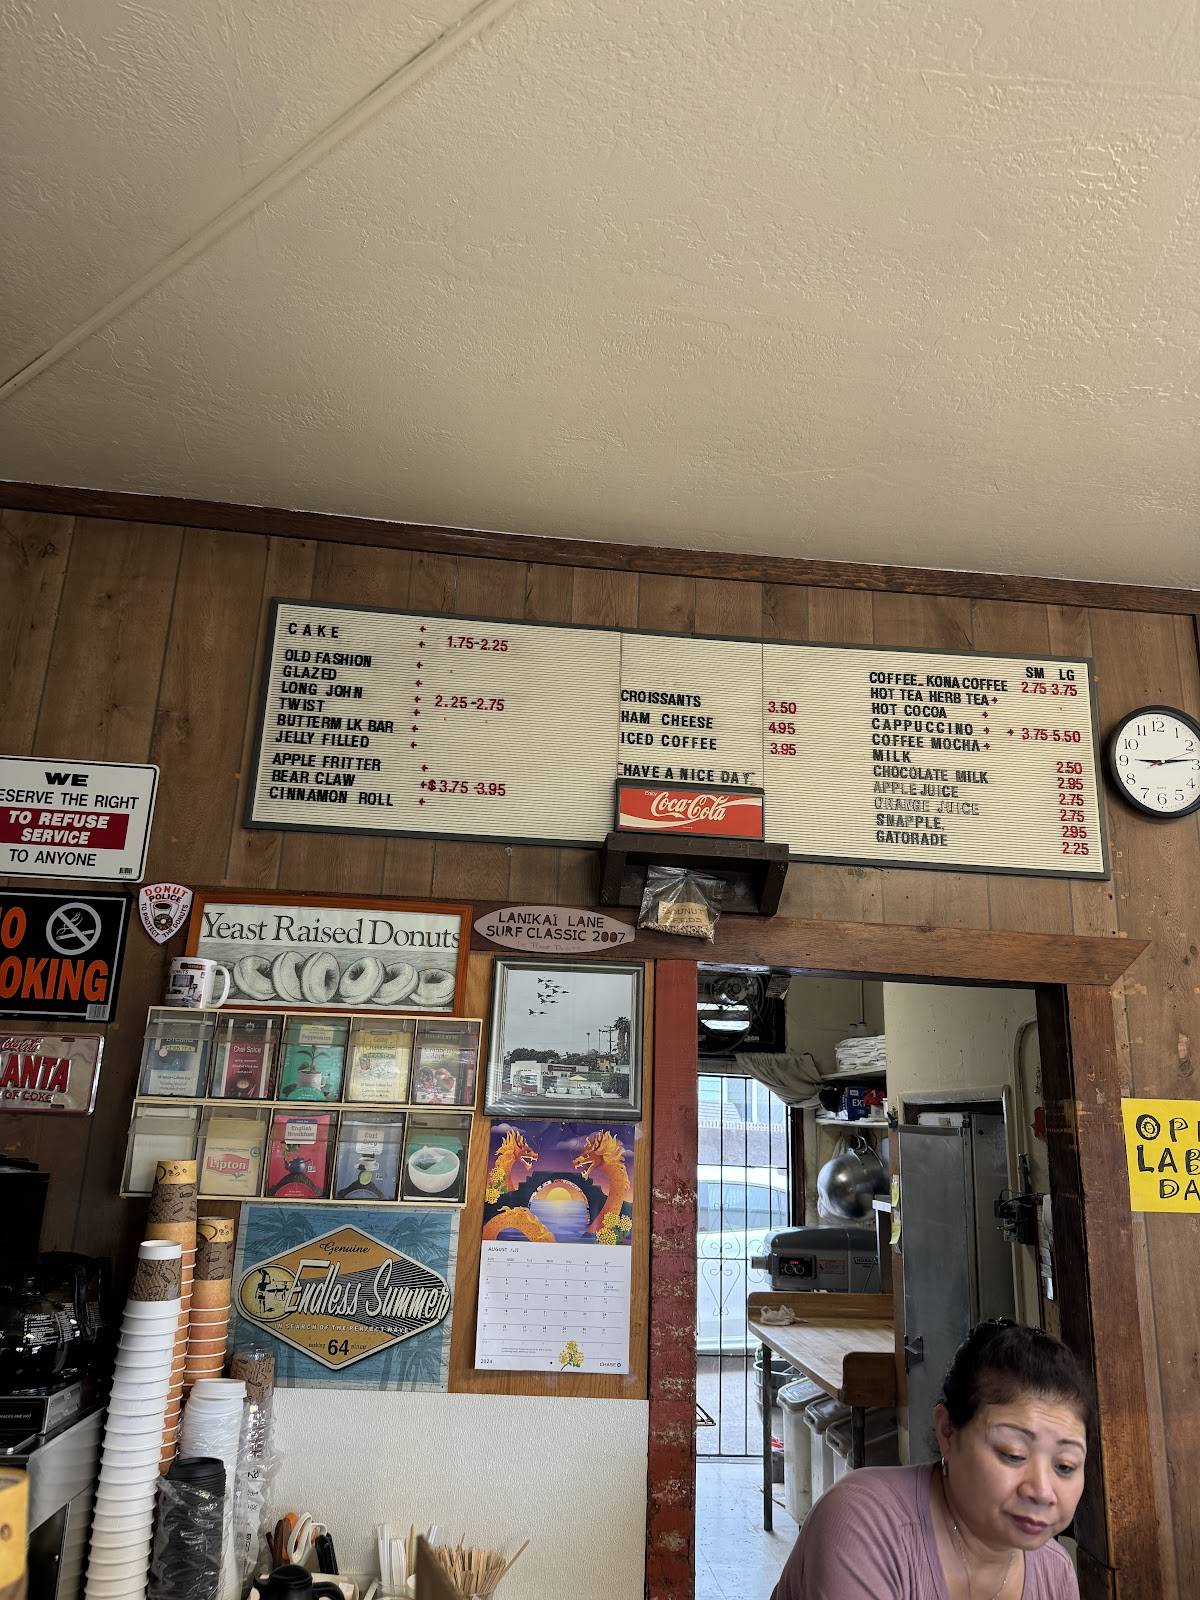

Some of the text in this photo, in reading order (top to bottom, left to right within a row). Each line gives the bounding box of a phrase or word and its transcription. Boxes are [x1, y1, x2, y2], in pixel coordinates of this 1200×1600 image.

[288, 622, 340, 639] CAKE
[284, 649, 372, 668] OLD FASHION
[283, 665, 338, 681] GLAZED
[1025, 667, 1075, 681] SM LG
[281, 681, 363, 699] LONG JOHN
[926, 674, 961, 689] KONA
[962, 677, 1009, 692] COFFEE
[1021, 681, 1078, 697] 2.75 3.75
[279, 697, 325, 713] TWIST
[621, 689, 702, 708] CROISSANTS
[870, 687, 990, 706] HOT TEA HERB TEA
[768, 700, 797, 714] 3.50
[871, 702, 948, 719] HOT COCOA
[368, 719, 394, 733] BAR
[621, 710, 715, 730] HAM CHEESE
[871, 717, 974, 736] CAPPUCCINO
[1152, 720, 1165, 732] 12
[1137, 724, 1147, 736] 11
[1175, 727, 1179, 739] 1
[275, 731, 370, 749] JELLY FILLED
[621, 731, 718, 751] ICED COFFEE
[872, 733, 981, 752] COFFEE MOCHA
[1124, 738, 1139, 750] 10
[1185, 740, 1194, 751] 2
[272, 752, 382, 772] APPLE FRITTER
[872, 748, 911, 763] MILK
[1119, 755, 1129, 766] 9
[623, 763, 754, 785] HAVE A NICE DAY
[1191, 759, 1200, 771] 3
[45, 771, 89, 787] WE
[271, 769, 356, 787] BEAR CLAW
[873, 765, 989, 784] CHOCOLATE MILK
[1126, 773, 1136, 785] 8
[1186, 777, 1196, 788] 4
[269, 785, 394, 807] CINNAMON ROLL
[873, 780, 959, 798] APPLE JUICE
[1140, 787, 1150, 799] 7
[1174, 789, 1185, 801] 5
[61, 792, 89, 806] THE
[94, 794, 139, 810] RIGHT
[650, 791, 730, 821] Coca-Cola
[874, 796, 980, 815] ORANGE JUICE
[1157, 793, 1168, 805] 6
[9, 810, 110, 829] TO REFUSE
[21, 828, 91, 845] SERVICE
[876, 830, 948, 847] GATORADE
[9, 849, 97, 867] TO ANYONE
[144, 885, 189, 898] DONUT
[148, 893, 183, 903] POLICE
[0, 906, 27, 949] O
[140, 902, 161, 938] TO PROTECT
[161, 904, 189, 939] THE DONUTS
[498, 911, 605, 929] LANIKAI LANE
[202, 912, 461, 949] Yeast Raised Donuts
[485, 925, 626, 943] SURF CLASSIC 2007
[0, 955, 109, 1002] OKING
[0, 1053, 71, 1093] ANTA
[23, 1091, 55, 1103] COKE
[1136, 1113, 1200, 1142] OP
[210, 1158, 247, 1171] Lipton
[1136, 1144, 1200, 1175] LAB
[1159, 1179, 1200, 1202] DA
[319, 1241, 371, 1255] Genuine
[285, 1259, 362, 1316] Endless
[365, 1258, 450, 1320] Summer
[285, 1323, 318, 1331] SEARCH
[327, 1339, 350, 1357] 64
